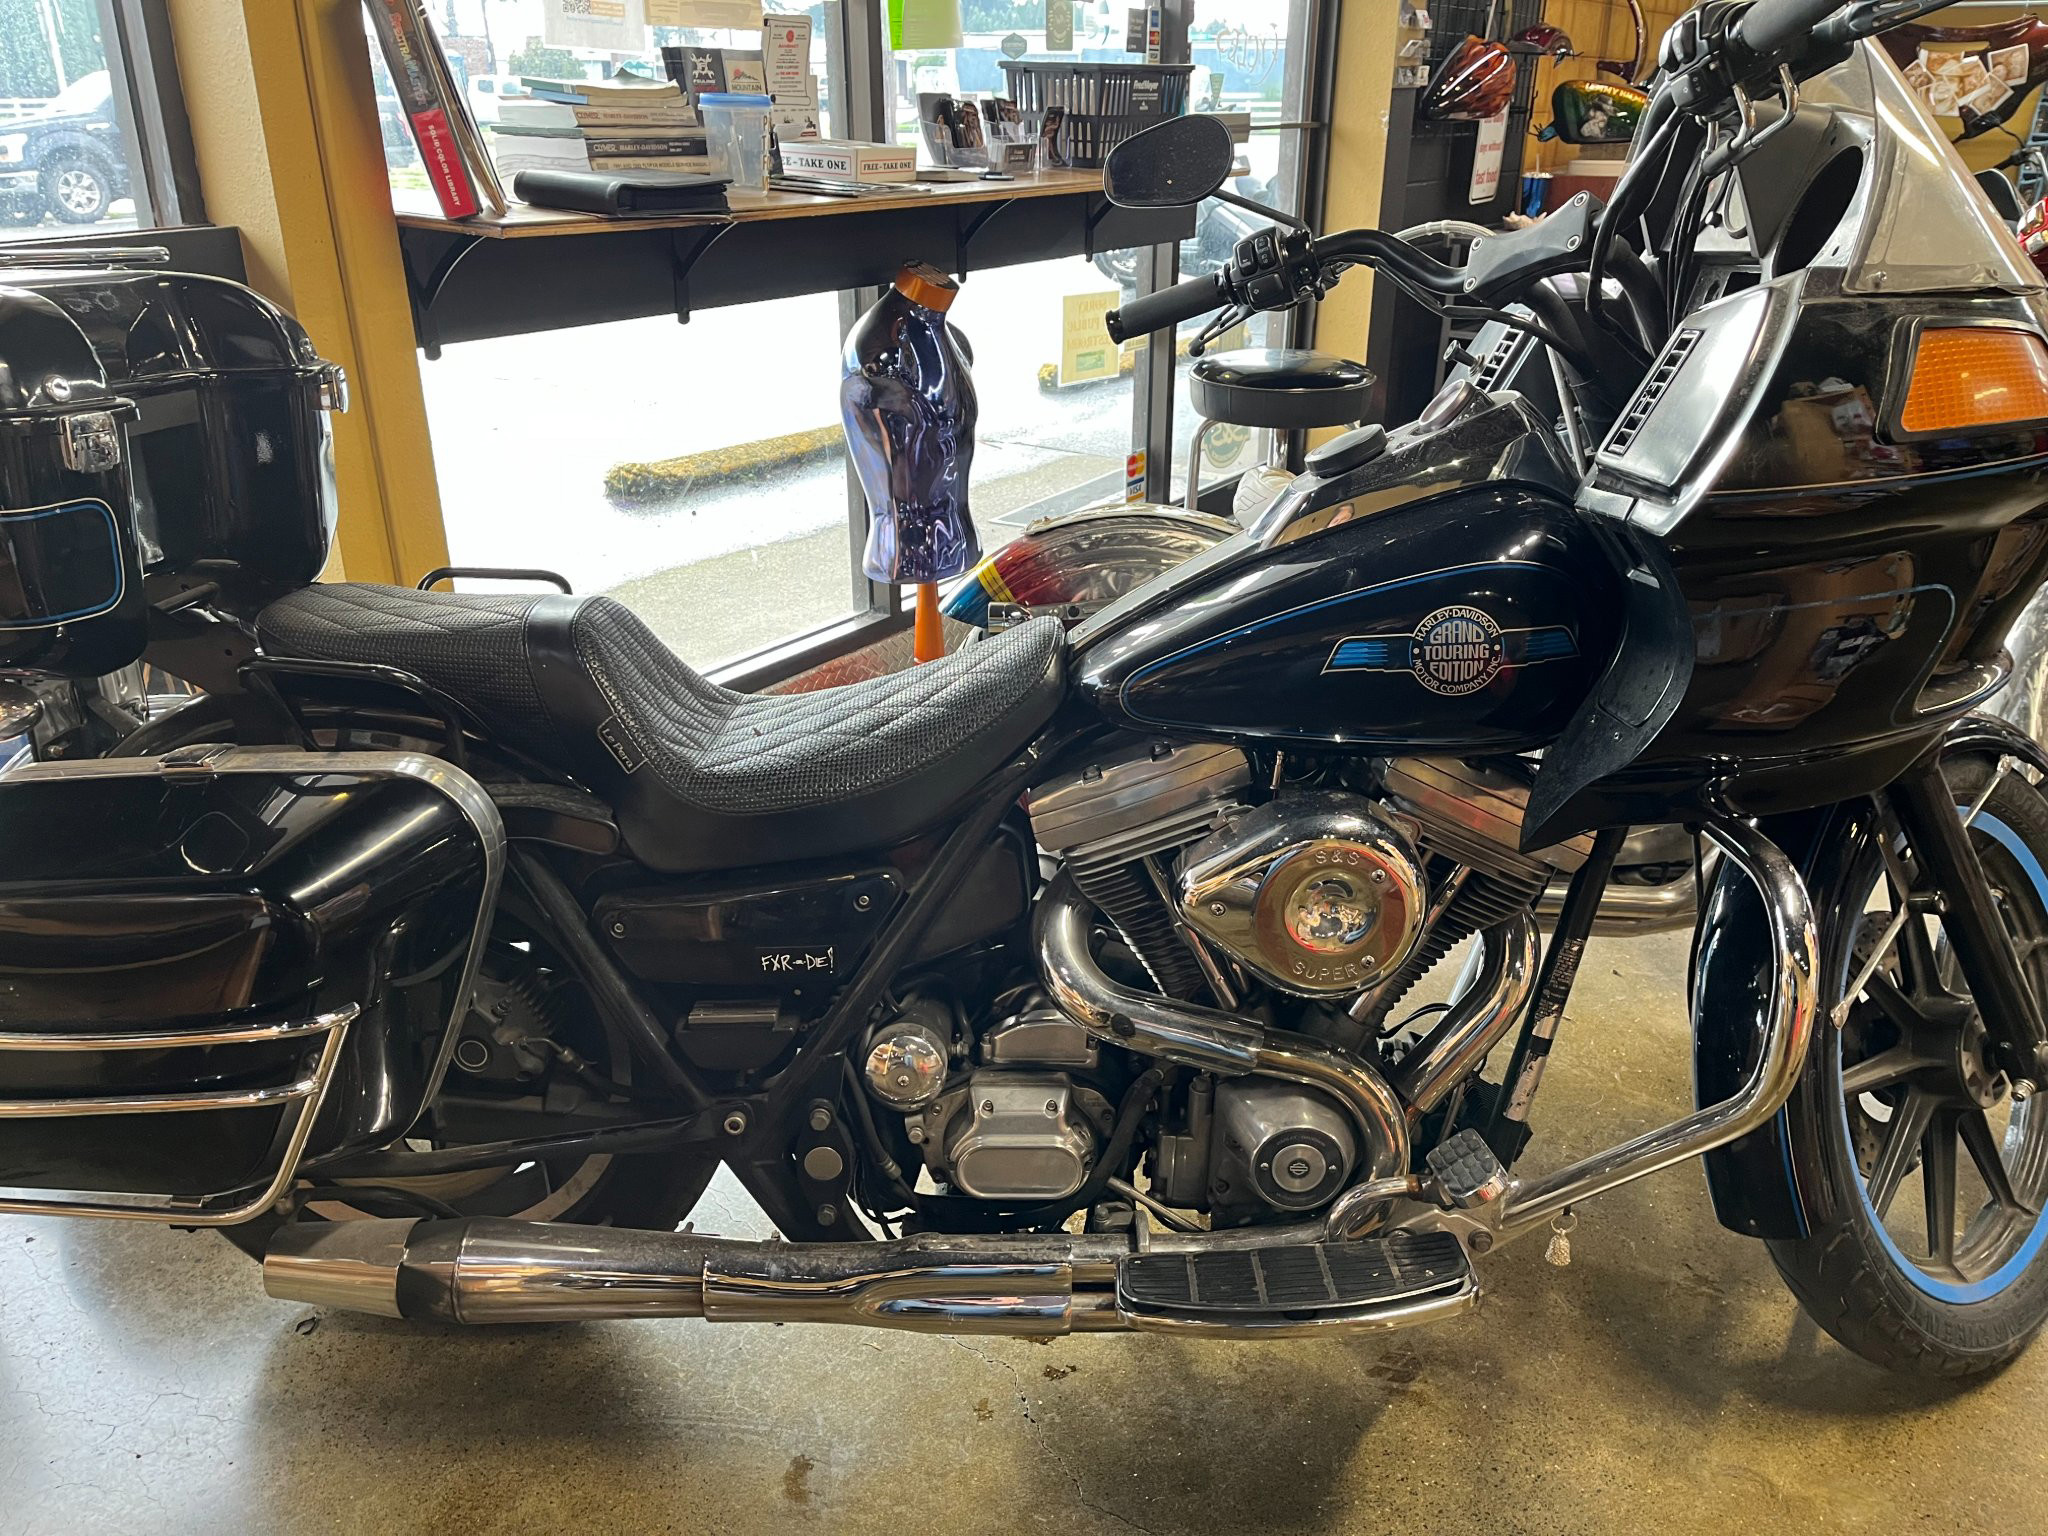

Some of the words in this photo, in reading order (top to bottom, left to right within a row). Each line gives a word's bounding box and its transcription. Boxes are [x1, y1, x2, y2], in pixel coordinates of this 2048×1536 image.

[828, 160, 847, 170] ONE
[436, 148, 450, 174] COLOR
[445, 175, 461, 206] LIBRARY
[1129, 484, 1142, 496] VISA
[1429, 620, 1485, 644] GRAND
[1424, 643, 1490, 661] TOURING
[1413, 659, 1440, 690] MOTOR
[1440, 672, 1489, 693] COMPANY
[1429, 660, 1484, 682] EDITION
[602, 728, 615, 742] Le
[613, 742, 633, 768] Pera
[1292, 961, 1358, 981] SUPER
